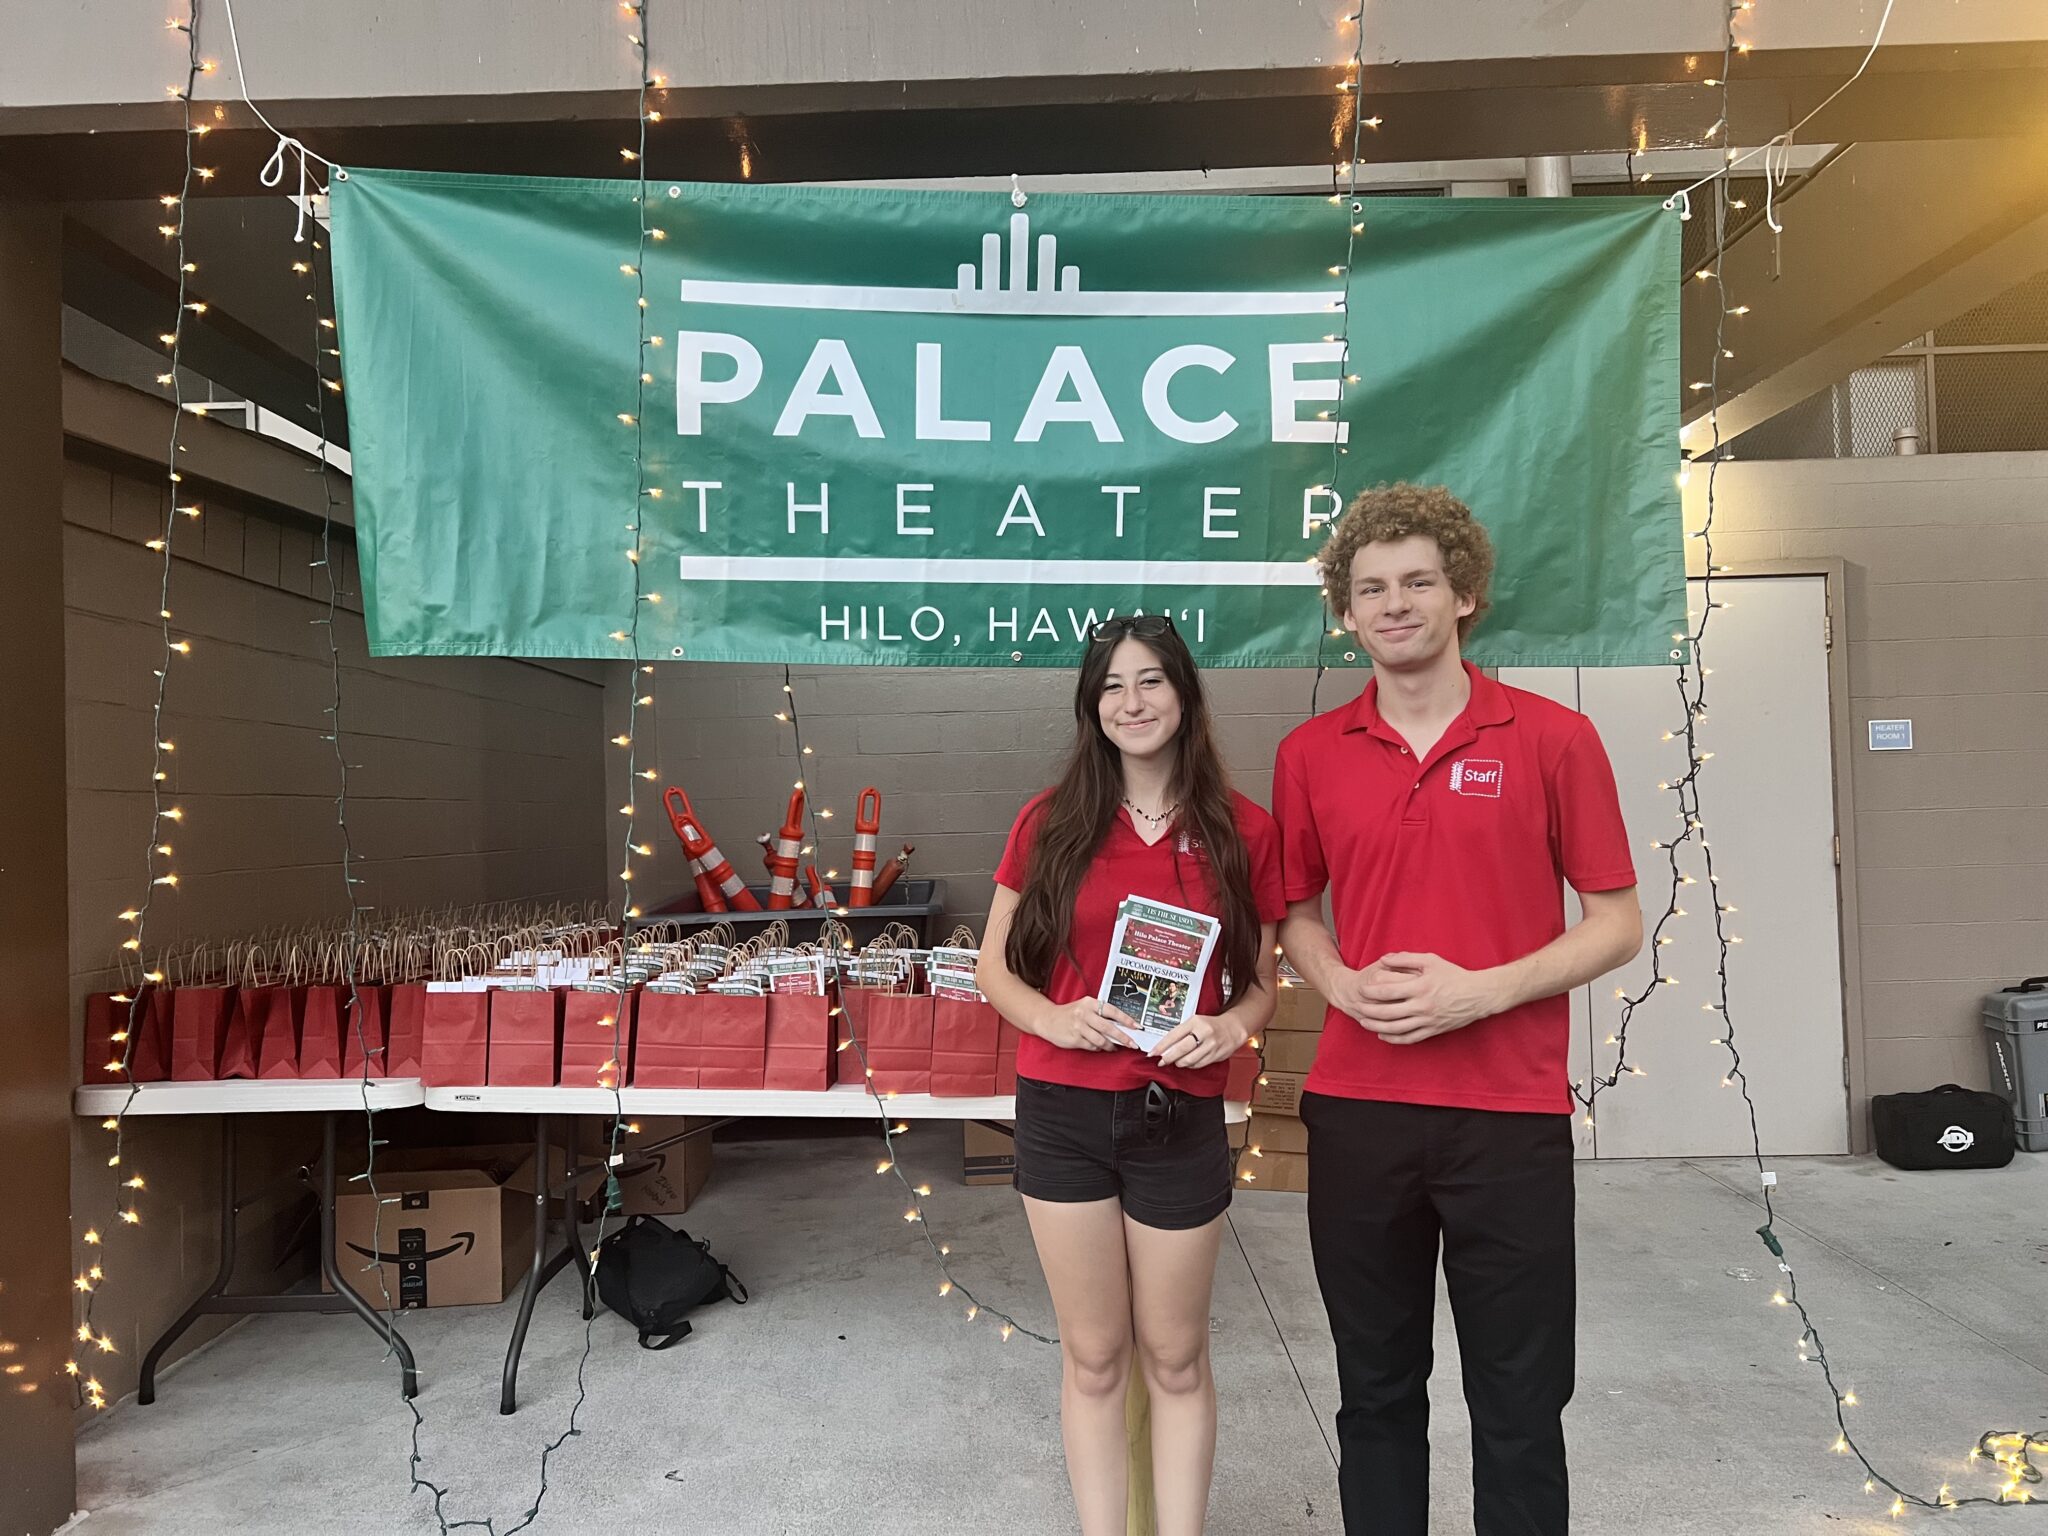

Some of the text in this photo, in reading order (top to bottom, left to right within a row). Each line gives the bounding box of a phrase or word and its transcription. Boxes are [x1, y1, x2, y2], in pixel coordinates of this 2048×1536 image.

[676, 330, 1350, 444] PALACE
[682, 480, 1343, 540] THEATER
[819, 605, 961, 648] HILO,
[1875, 724, 1905, 732] HEATER
[1876, 732, 1900, 740] ROOM
[1464, 769, 1498, 783] Staff
[1134, 930, 1148, 939] Hilo
[1148, 933, 1168, 944] Palace
[1168, 939, 1192, 951] Theater
[1120, 958, 1161, 975] UPCOMING
[1161, 968, 1190, 981] SHOWS
[1995, 1041, 2013, 1091] MACKIE
